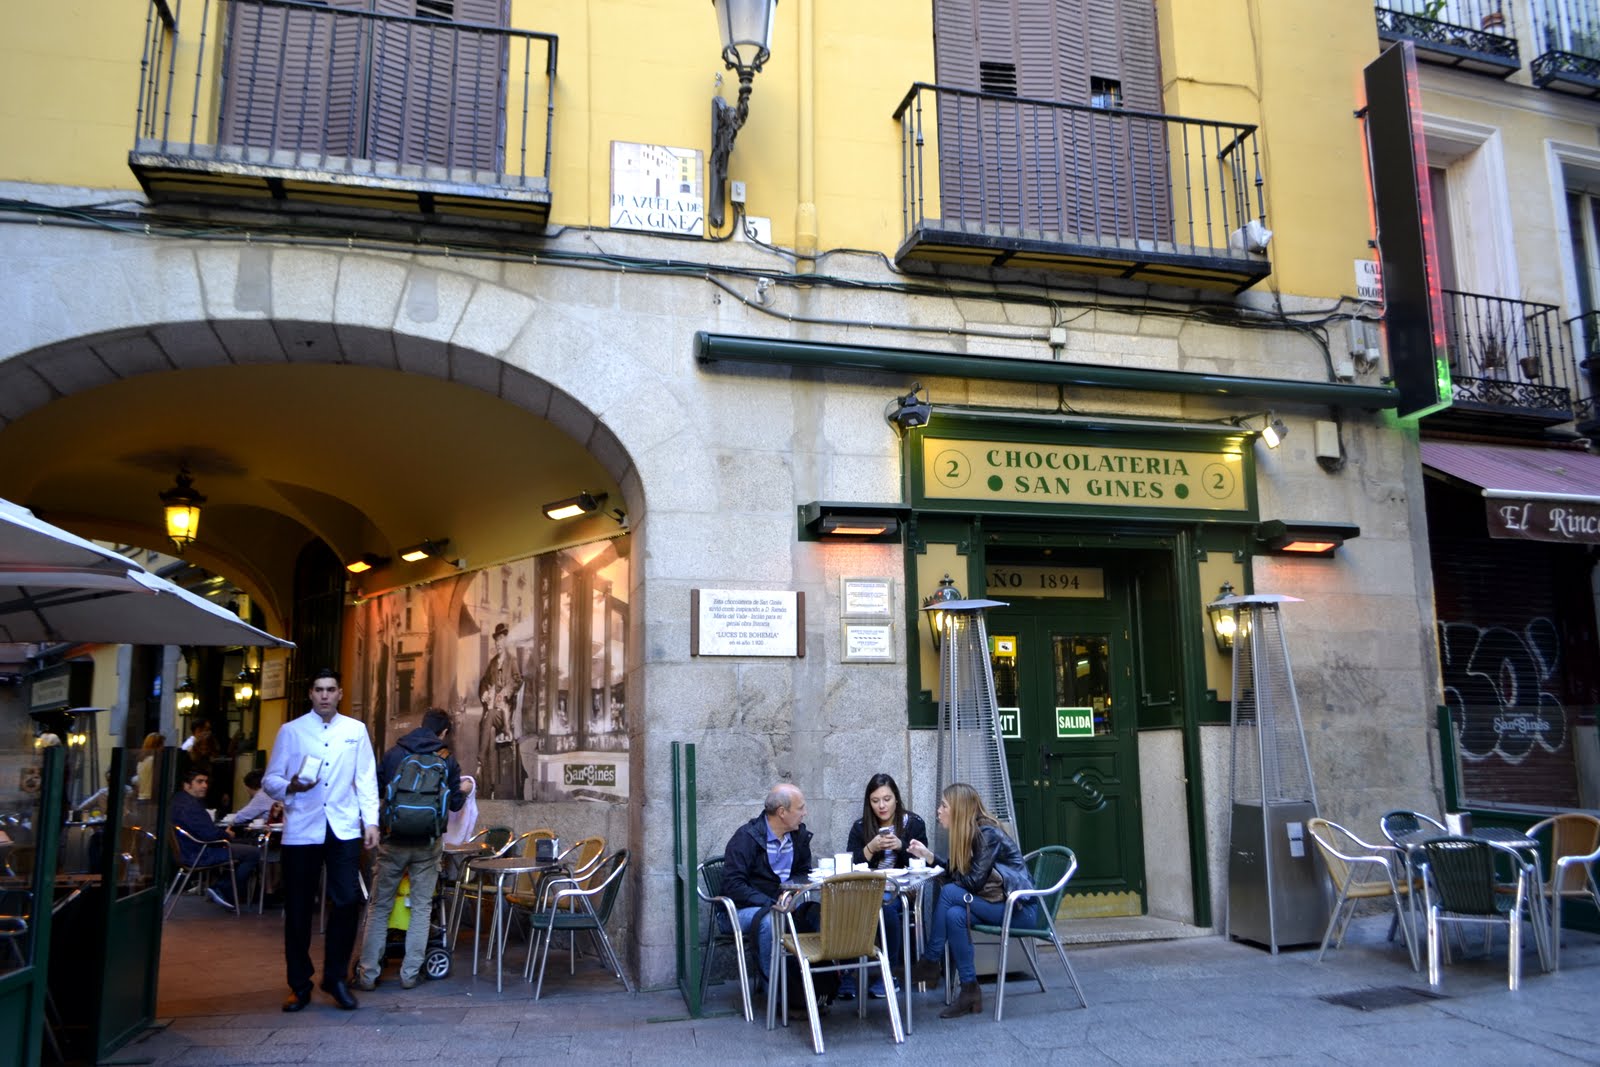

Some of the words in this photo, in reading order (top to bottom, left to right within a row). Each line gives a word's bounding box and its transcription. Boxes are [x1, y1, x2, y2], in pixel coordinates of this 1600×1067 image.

[612, 193, 684, 212] PLAZUELA
[746, 220, 758, 239] 5
[945, 460, 960, 478] 2
[986, 449, 1190, 477] CHOCOLATERIA
[1014, 475, 1070, 495] SAN
[1086, 478, 1164, 499] GINES
[1212, 472, 1225, 490] 2
[1499, 503, 1533, 530] El
[1548, 507, 1600, 538] Rinc
[1039, 573, 1081, 590] 1894
[1058, 715, 1092, 730] SALIDA
